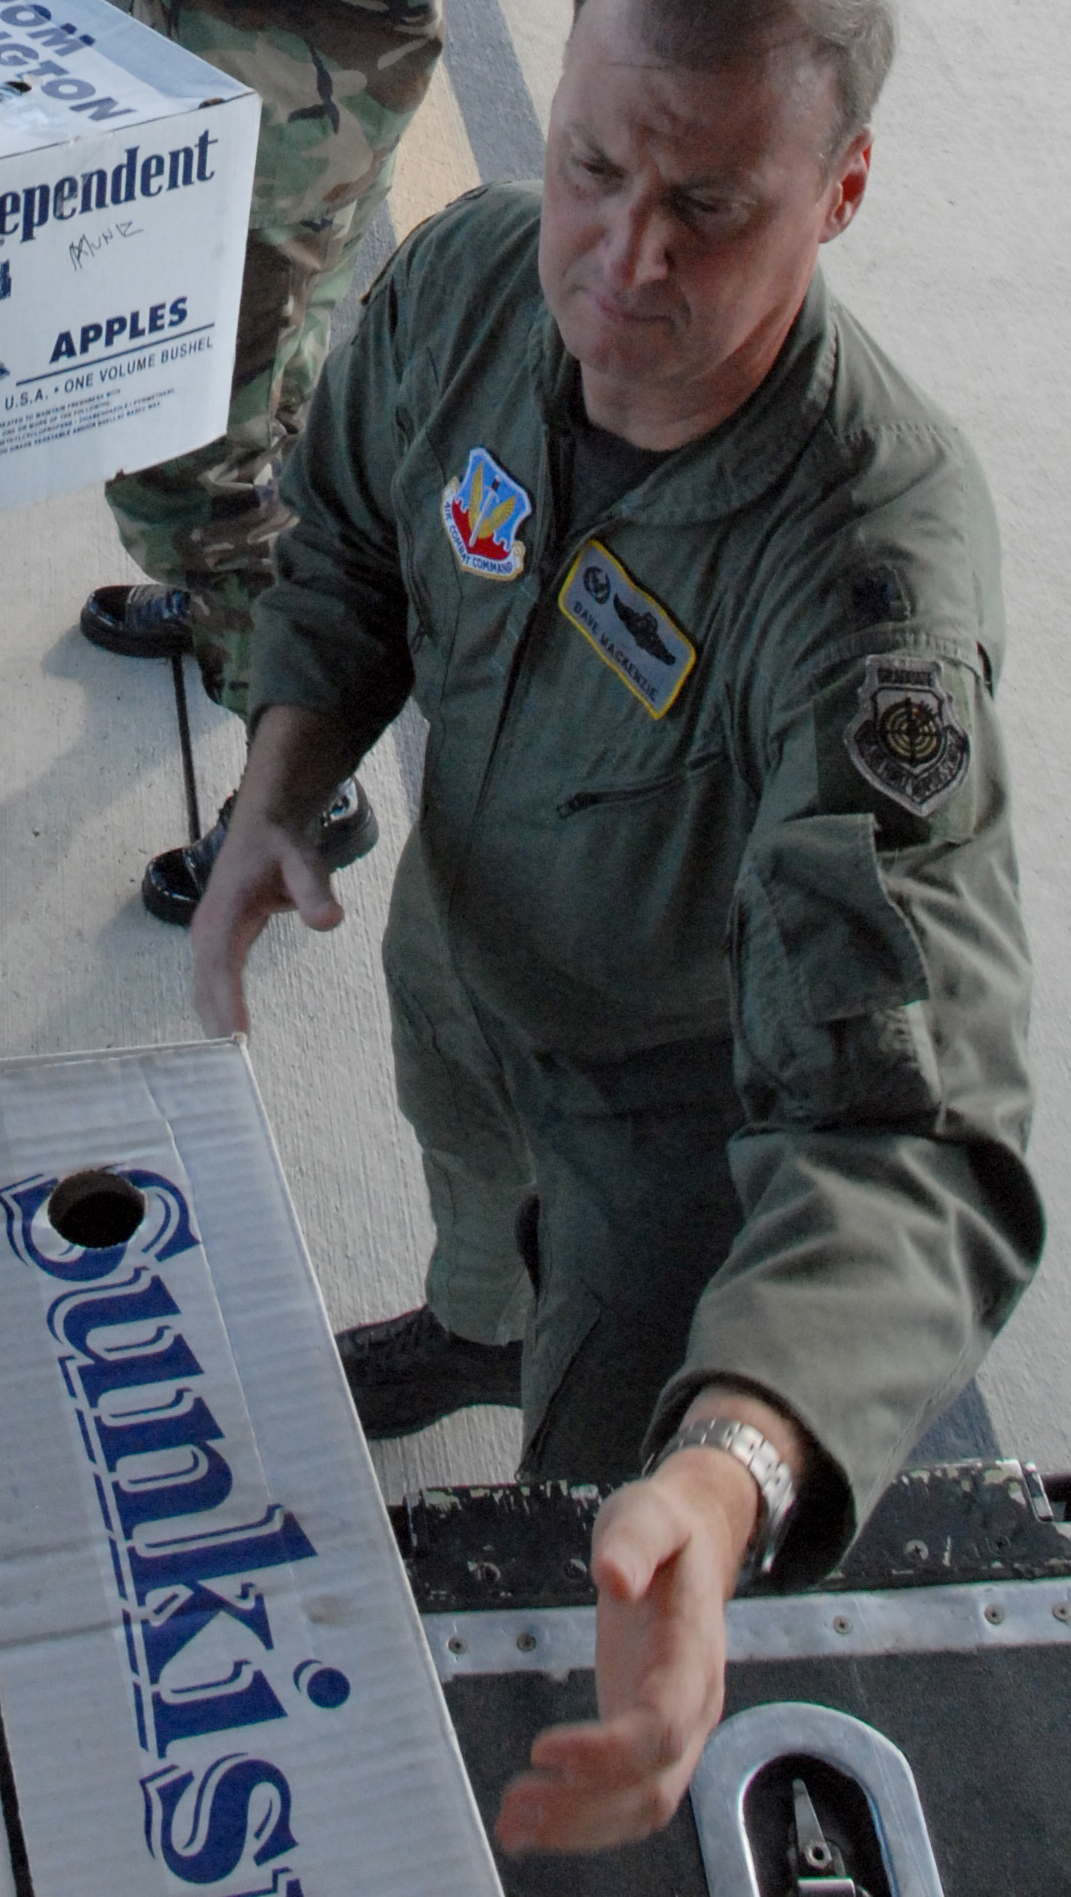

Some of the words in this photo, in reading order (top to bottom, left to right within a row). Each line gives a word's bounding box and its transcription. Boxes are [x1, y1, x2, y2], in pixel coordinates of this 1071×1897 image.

[49, 296, 188, 365] APPLES
[5, 387, 49, 411] U.S.A.
[65, 373, 94, 393] ONE
[99, 354, 156, 383] VOLUME
[161, 336, 213, 364] BUSHEL
[472, 556, 514, 574] COMMAND
